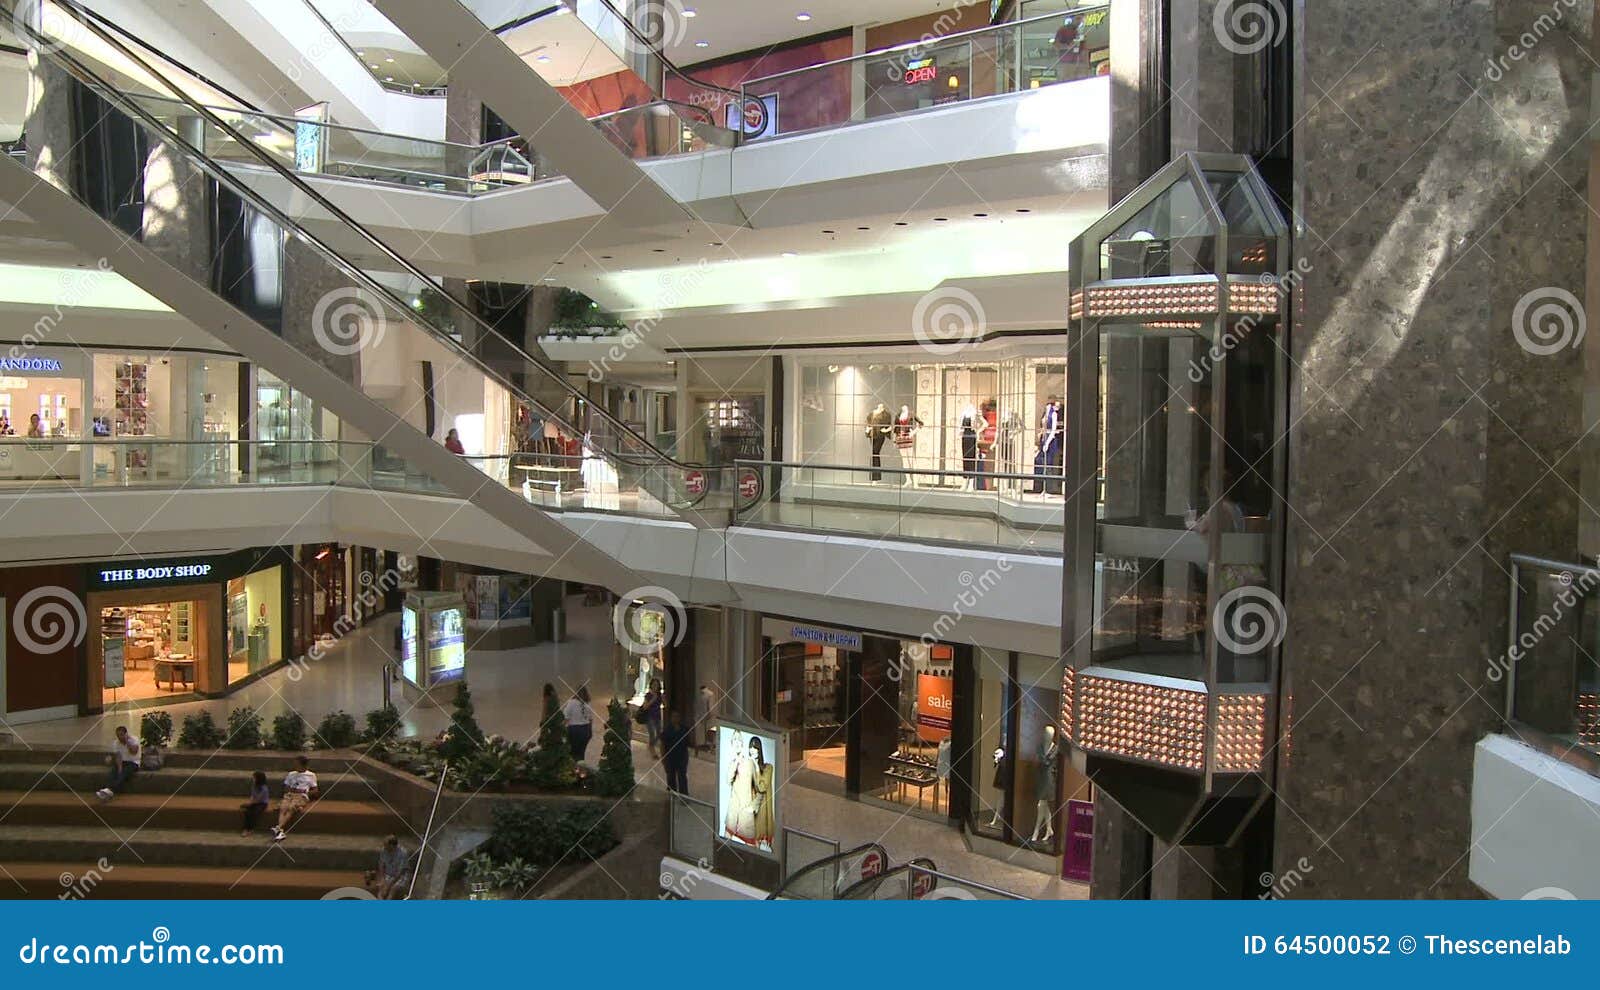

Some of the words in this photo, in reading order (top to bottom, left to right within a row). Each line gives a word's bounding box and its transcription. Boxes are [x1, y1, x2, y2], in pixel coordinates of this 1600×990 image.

[905, 67, 936, 84] OPEN
[101, 570, 133, 582] THE
[135, 567, 174, 580] BODY
[175, 564, 212, 577] SHOP
[927, 694, 953, 710] sale
